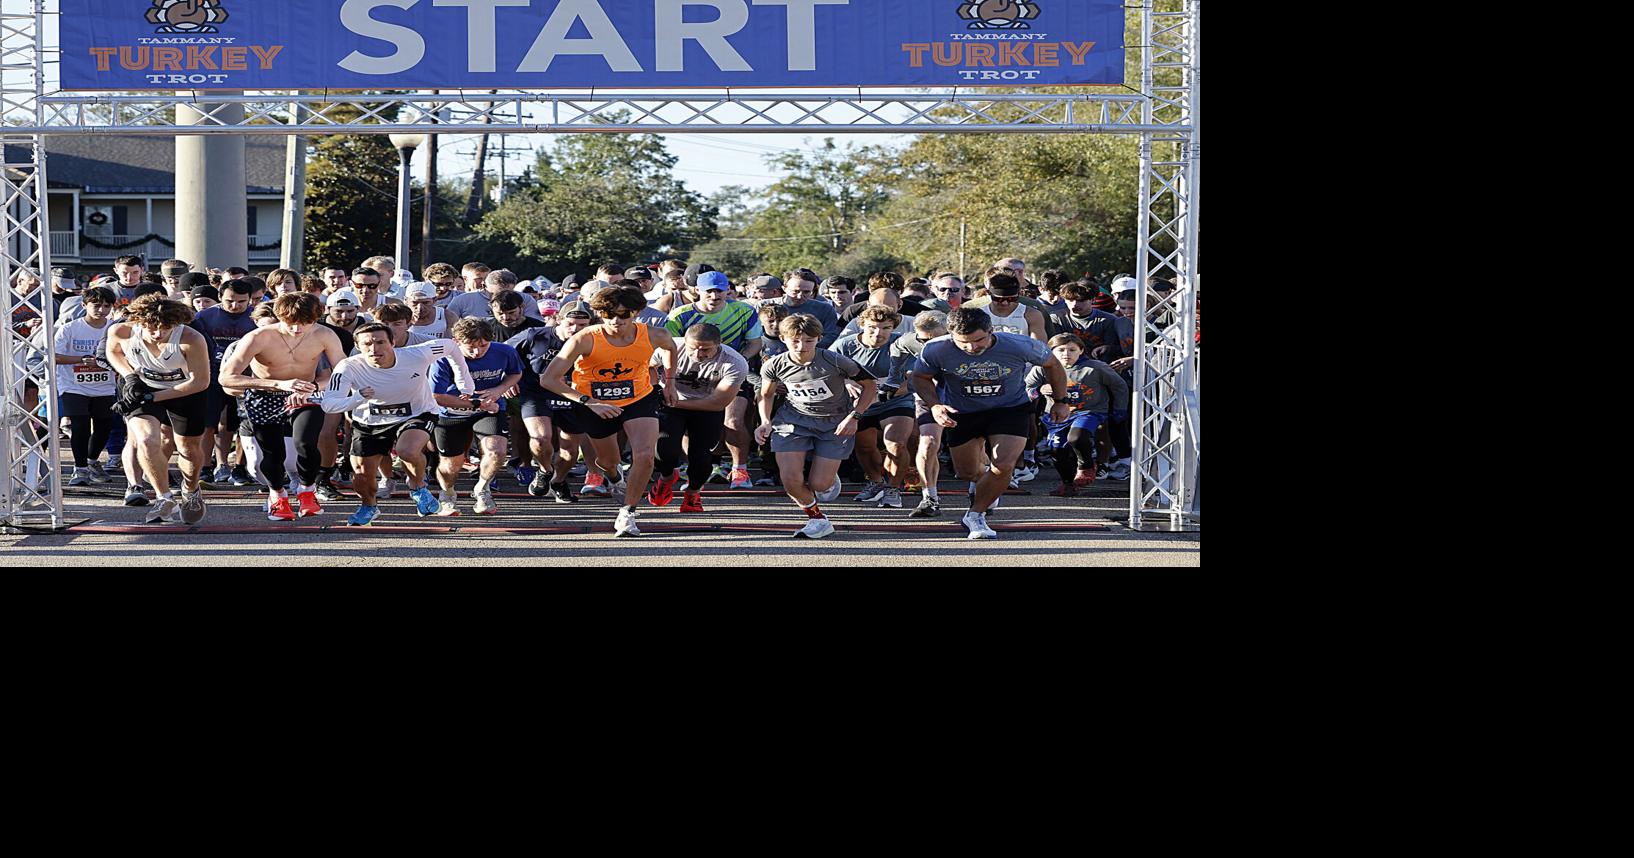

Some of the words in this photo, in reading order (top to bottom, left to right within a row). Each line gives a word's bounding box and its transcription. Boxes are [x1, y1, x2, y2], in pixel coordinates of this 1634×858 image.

[337, 0, 849, 75] START
[89, 45, 284, 72] TURKEY
[901, 41, 1096, 68] TURKEY
[145, 74, 229, 84] TROT
[958, 70, 1041, 80] TROT
[76, 373, 109, 383] 9386
[594, 387, 631, 397] 1293
[791, 386, 828, 397] 3154
[964, 384, 1002, 394] 1567
